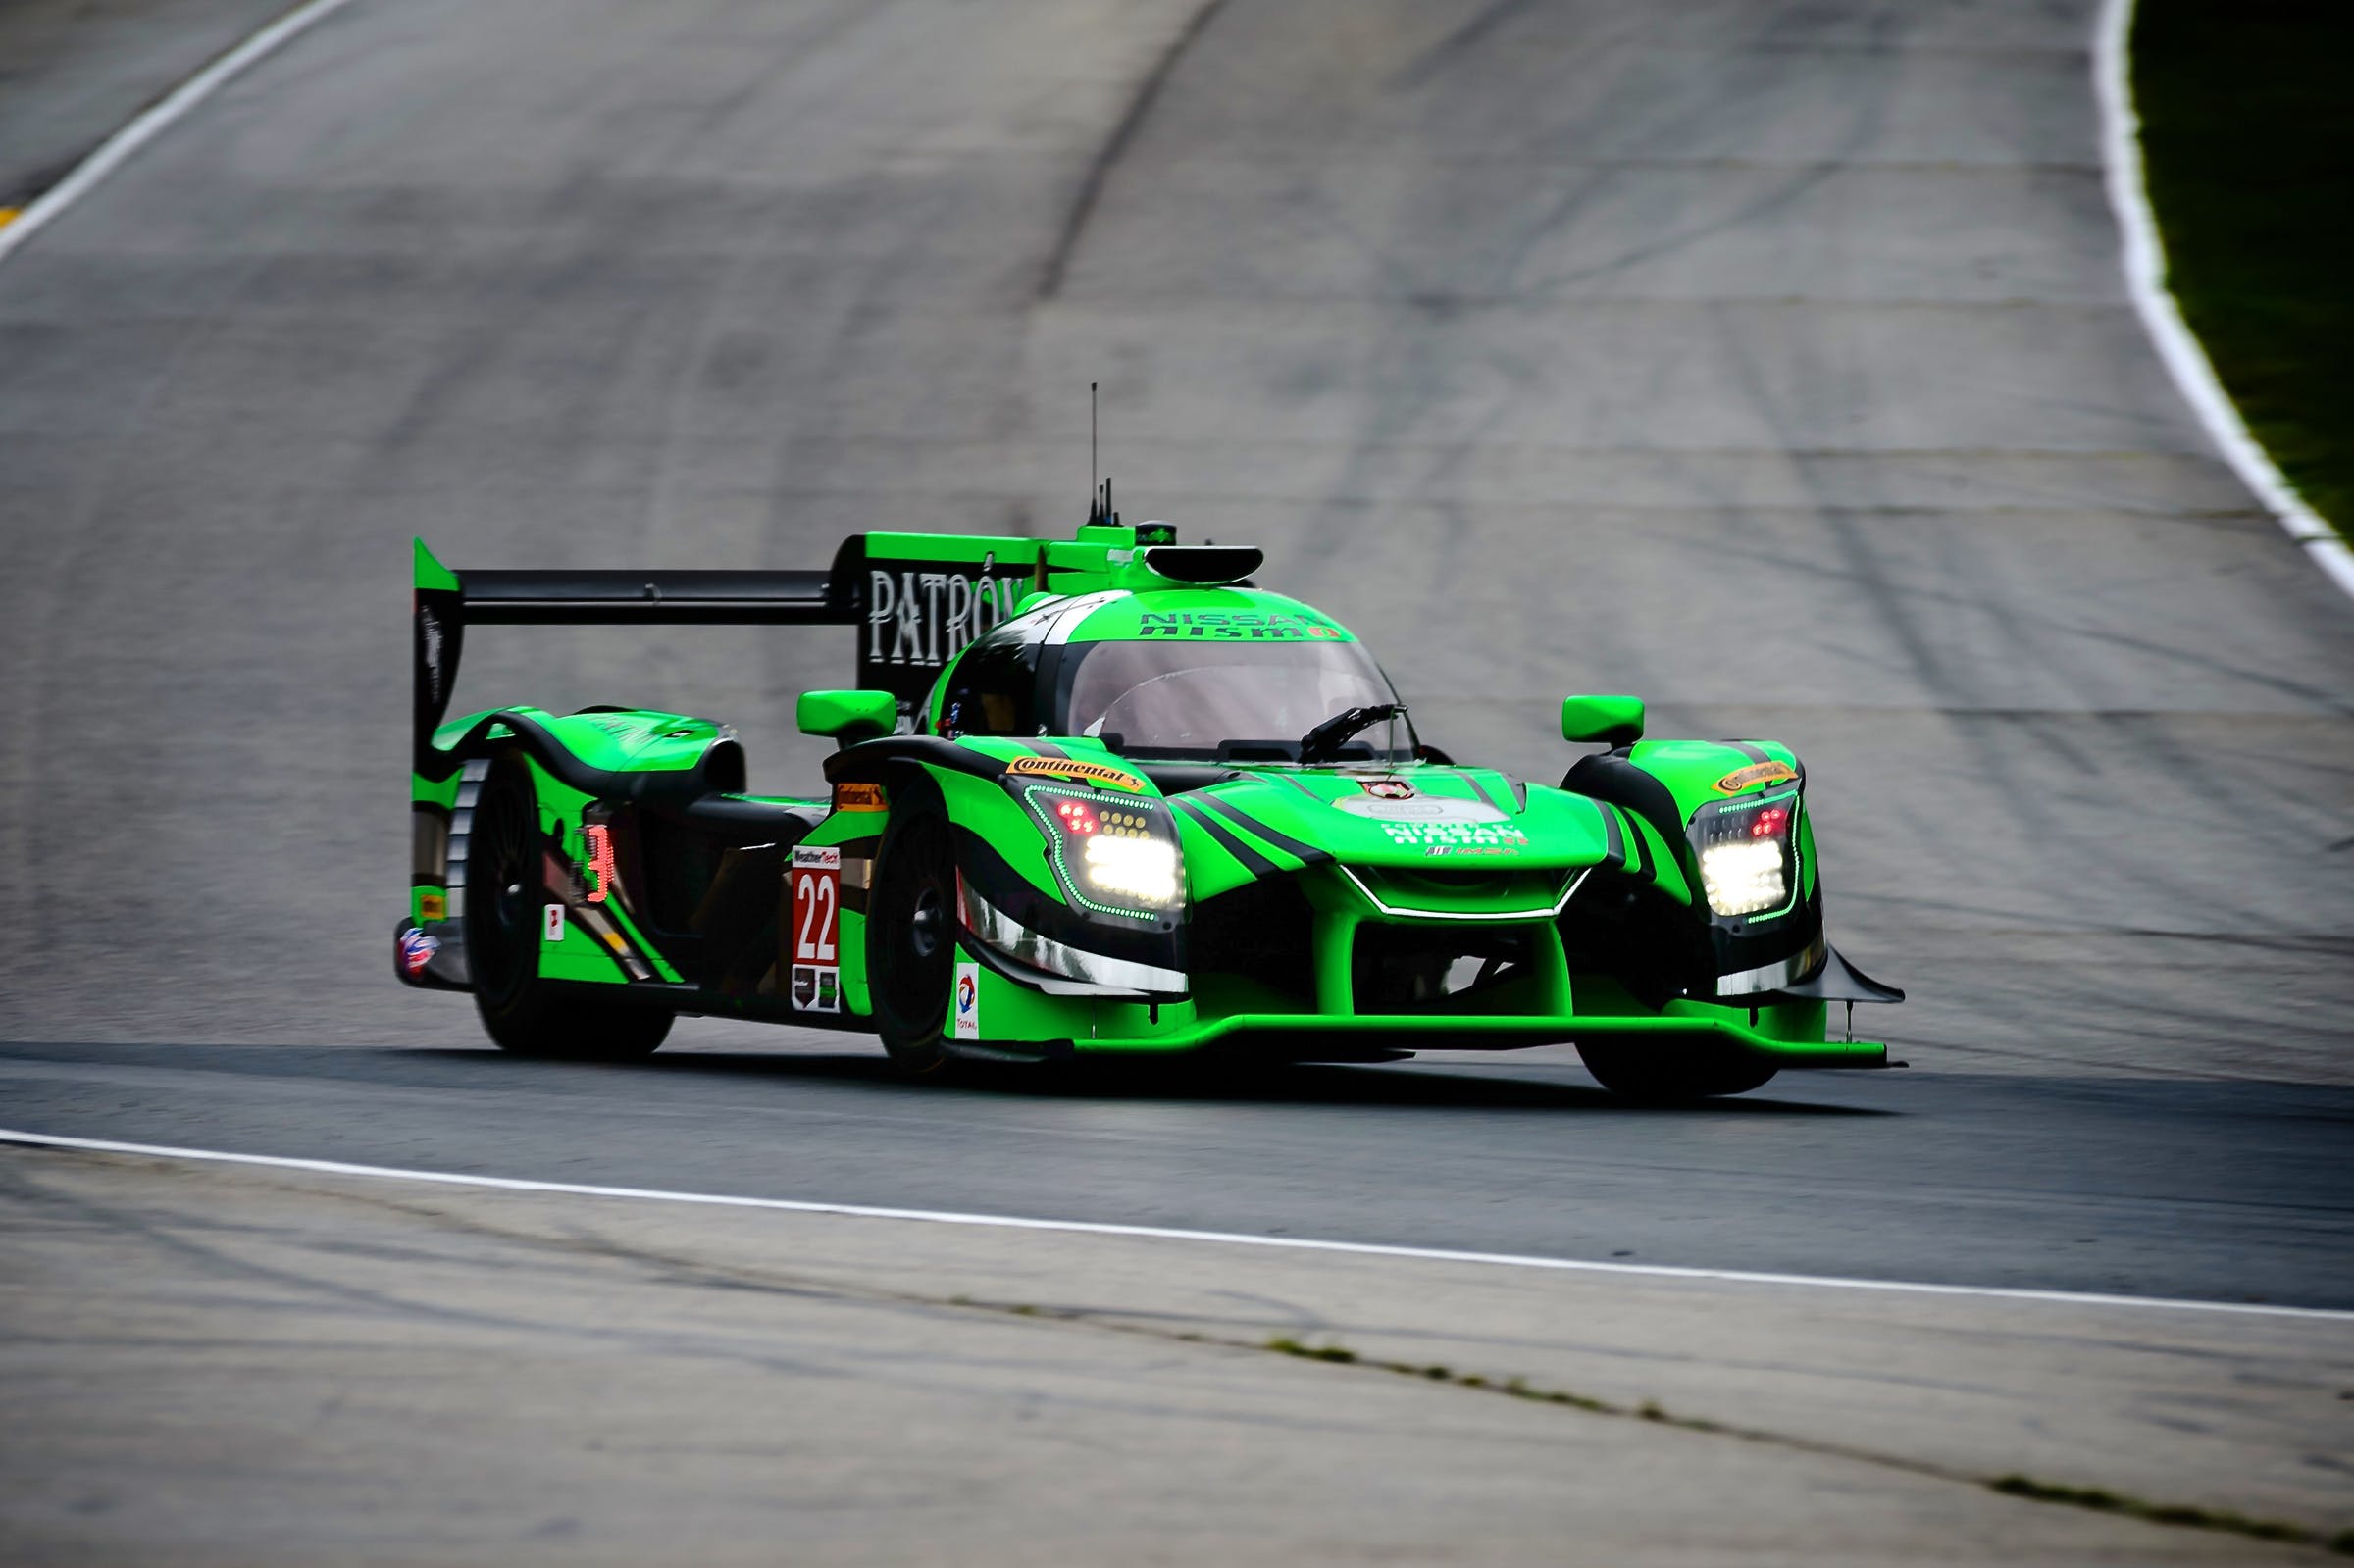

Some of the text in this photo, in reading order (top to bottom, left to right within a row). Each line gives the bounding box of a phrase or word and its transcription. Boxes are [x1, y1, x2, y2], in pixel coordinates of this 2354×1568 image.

[1140, 613, 1332, 627] NISSAN
[1013, 756, 1124, 782] Continental
[796, 873, 836, 961] 22
